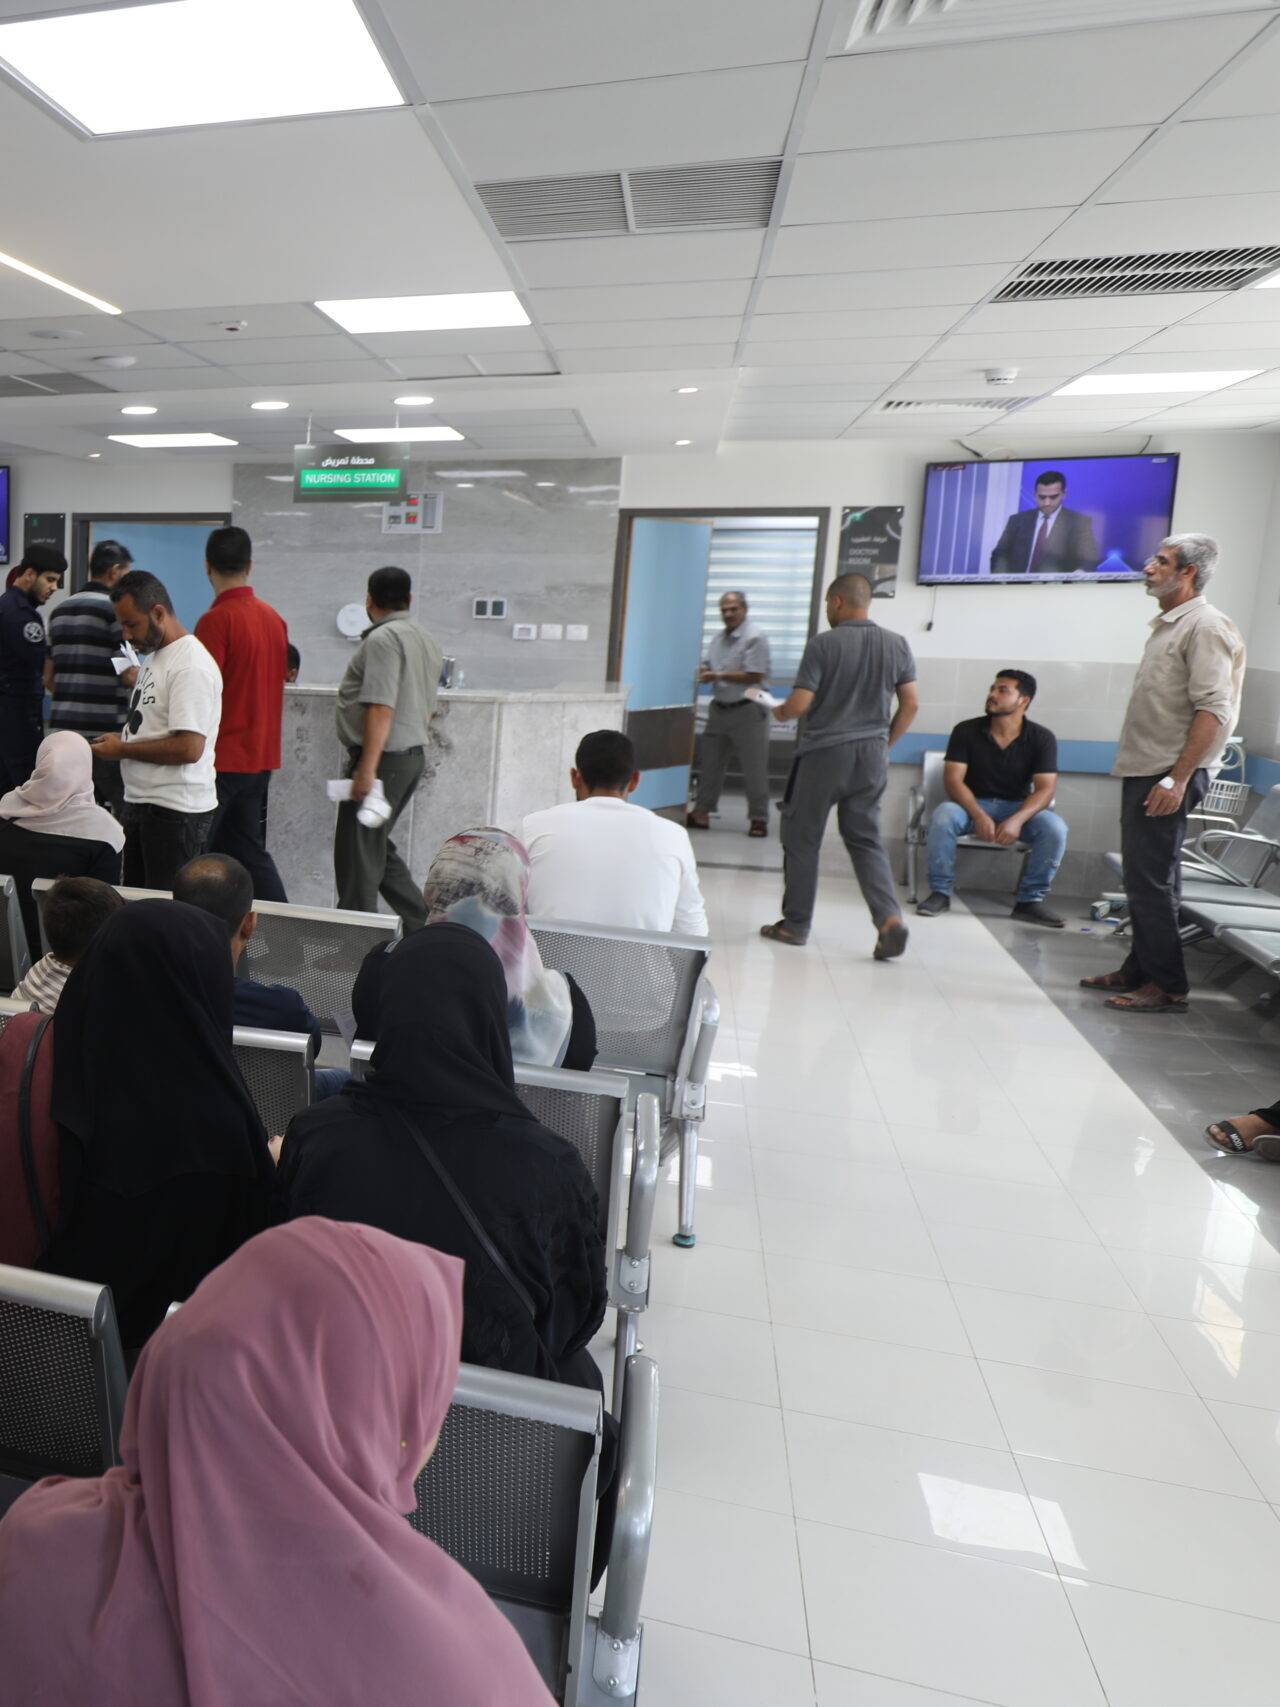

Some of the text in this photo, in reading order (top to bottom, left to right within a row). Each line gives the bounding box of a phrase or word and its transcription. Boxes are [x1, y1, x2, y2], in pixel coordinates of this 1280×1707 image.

[321, 456, 376, 467] محطة تمريض
[305, 472, 396, 483] NURSING STATION
[848, 547, 880, 556] DOCTOR
